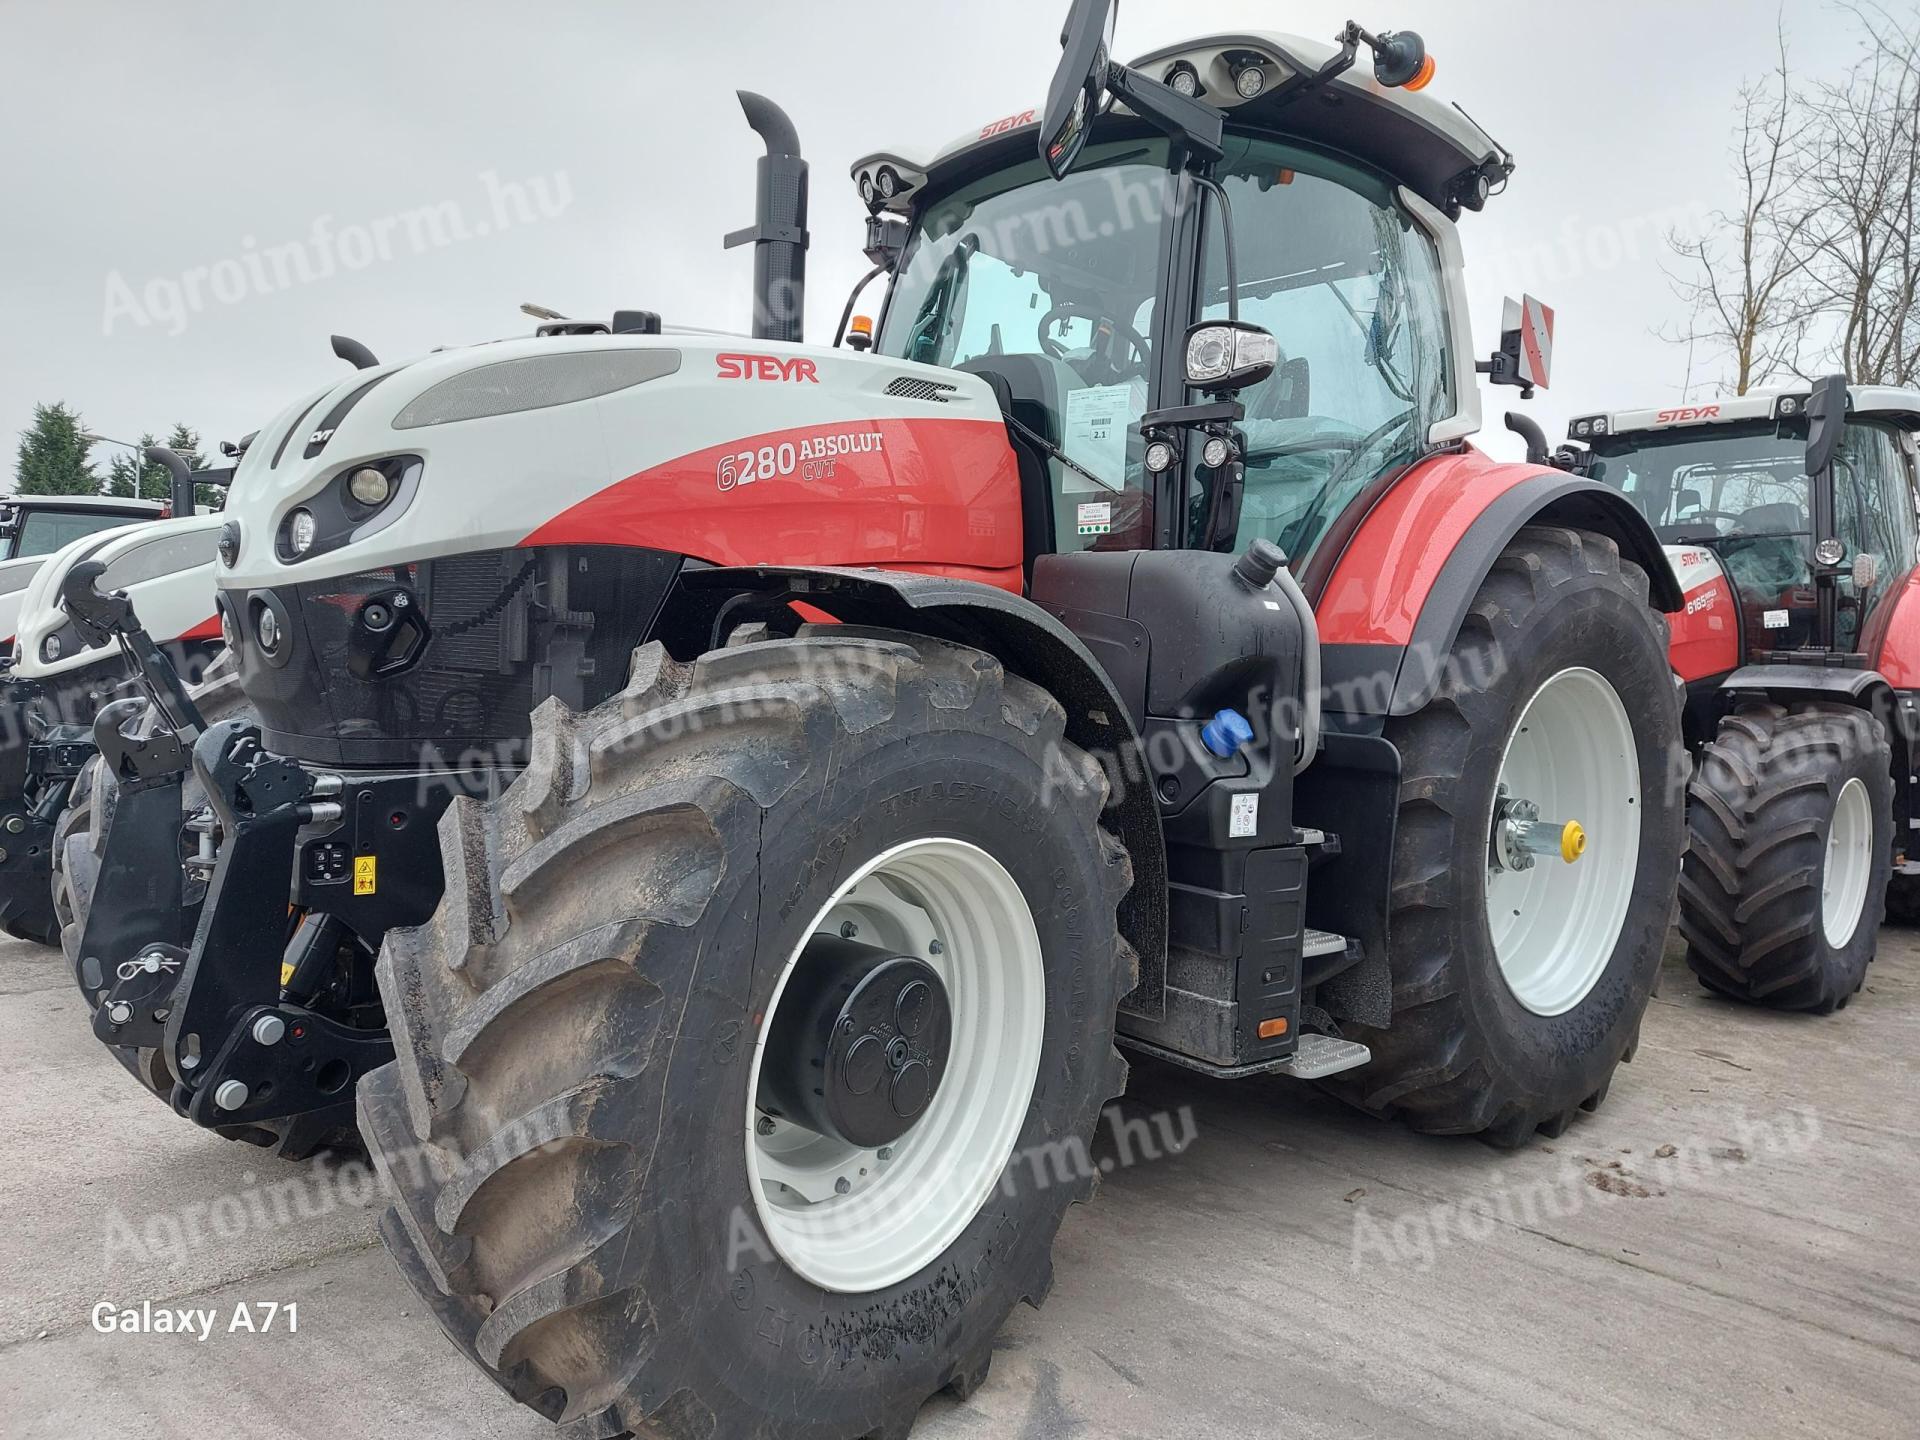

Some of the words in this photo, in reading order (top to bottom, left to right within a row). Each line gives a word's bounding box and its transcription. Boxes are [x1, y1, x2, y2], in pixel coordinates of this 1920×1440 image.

[979, 109, 1035, 139] STEYR
[716, 353, 820, 383] STEYR
[1656, 406, 1720, 423] STEYR
[1094, 431, 1106, 439] 2.1
[717, 442, 796, 492] 6280
[800, 433, 883, 460] ABSOLUT
[802, 458, 836, 481] CVT
[1687, 595, 1707, 615] 6165
